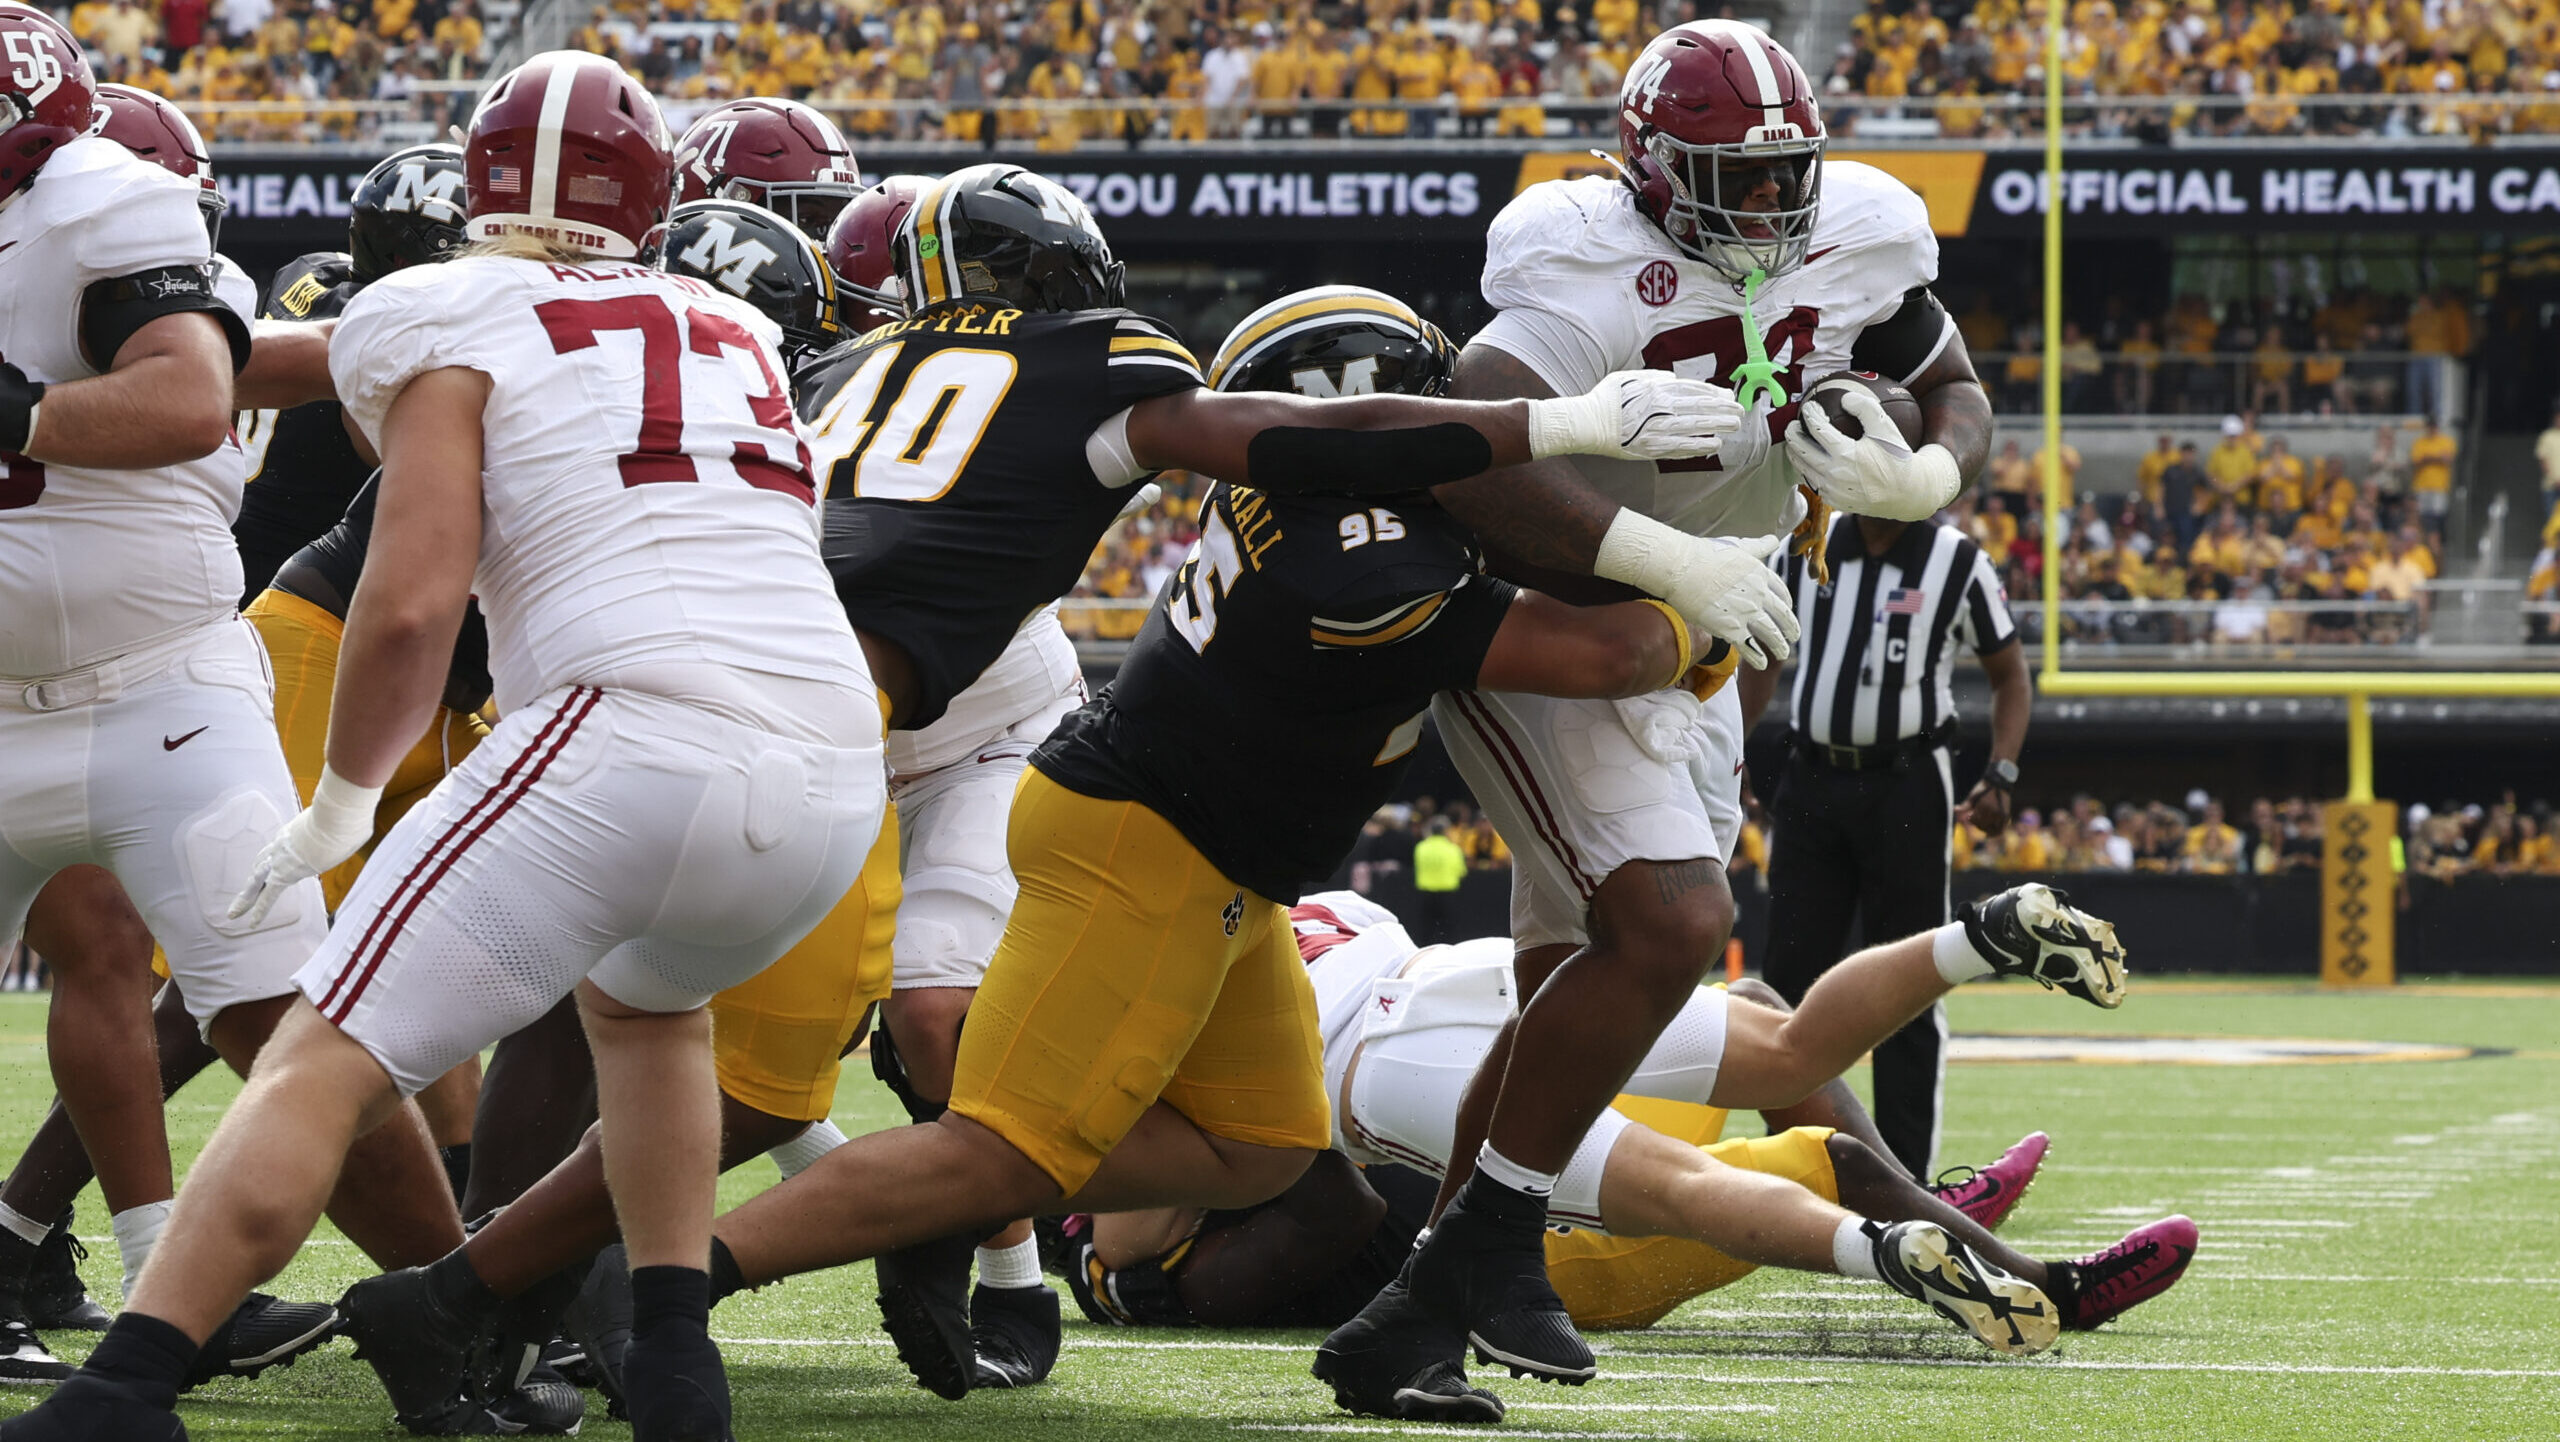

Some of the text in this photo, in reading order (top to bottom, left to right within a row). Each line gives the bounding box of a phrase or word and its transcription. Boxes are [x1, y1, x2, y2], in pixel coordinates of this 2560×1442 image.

[2, 31, 62, 90] 56
[1627, 52, 1672, 115] 74
[696, 120, 740, 168] 71
[1762, 128, 1793, 141] BAMA
[216, 174, 362, 217] HEAL
[385, 163, 467, 224] M
[833, 171, 855, 183] BAMA
[1190, 172, 1480, 217] ATHLETICS
[1992, 170, 2247, 214] OFFICIAL
[2262, 169, 2475, 213] HEALTH
[565, 230, 606, 249] TIDE
[678, 216, 779, 298] M
[920, 238, 937, 252] C2P
[1640, 264, 1676, 304] SEC
[534, 295, 819, 508] 73
[808, 340, 1018, 502] 40
[1338, 508, 1406, 551] 95
[1887, 638, 1906, 662] C
